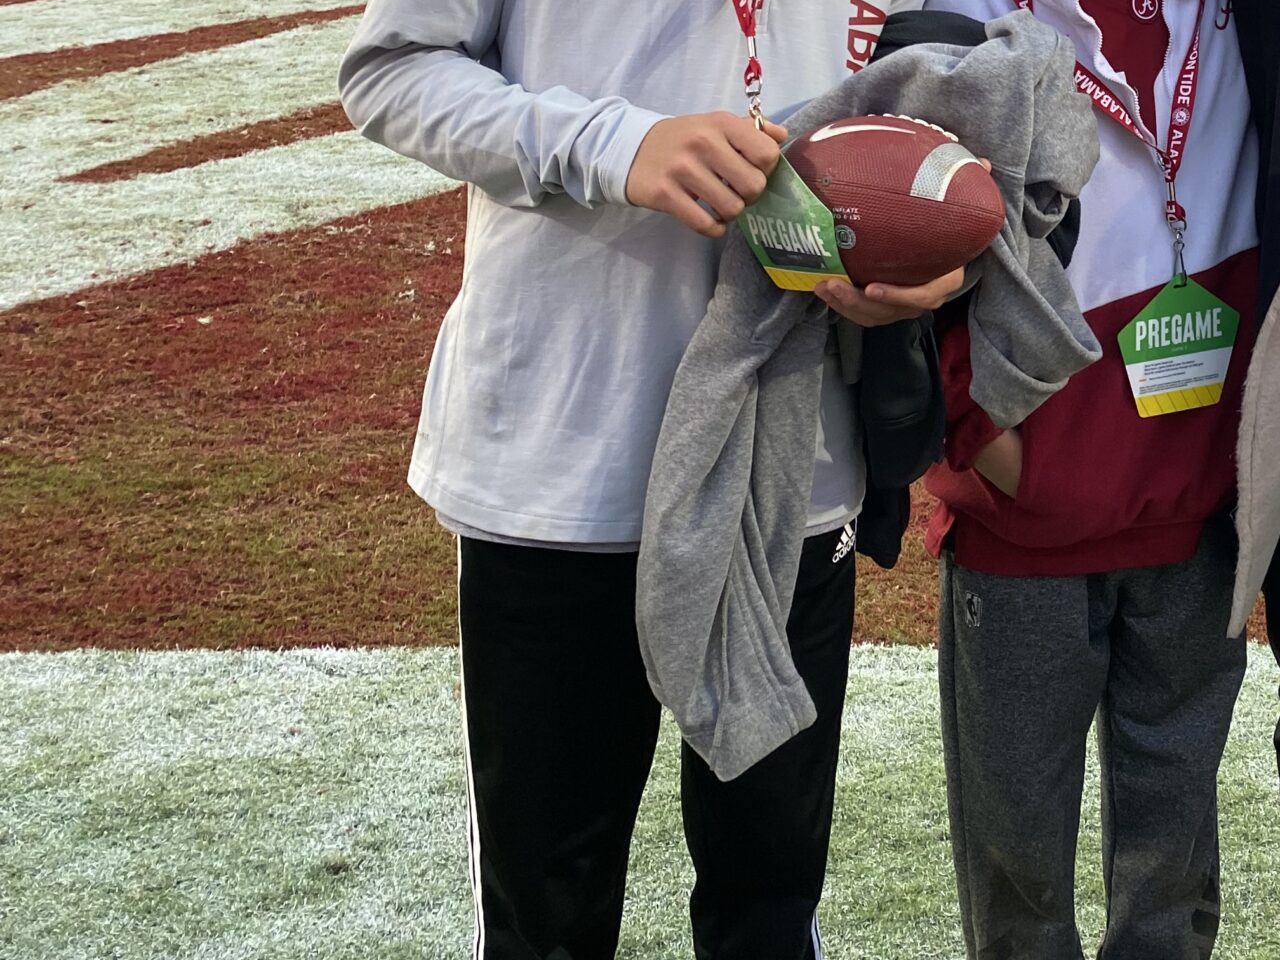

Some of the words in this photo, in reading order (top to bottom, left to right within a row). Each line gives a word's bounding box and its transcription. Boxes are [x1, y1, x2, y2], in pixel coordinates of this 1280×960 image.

[1074, 70, 1132, 126] ALABAMA
[1177, 71, 1194, 105] TIDE
[746, 213, 832, 257] PREGAME
[1134, 307, 1223, 352] PREGAME
